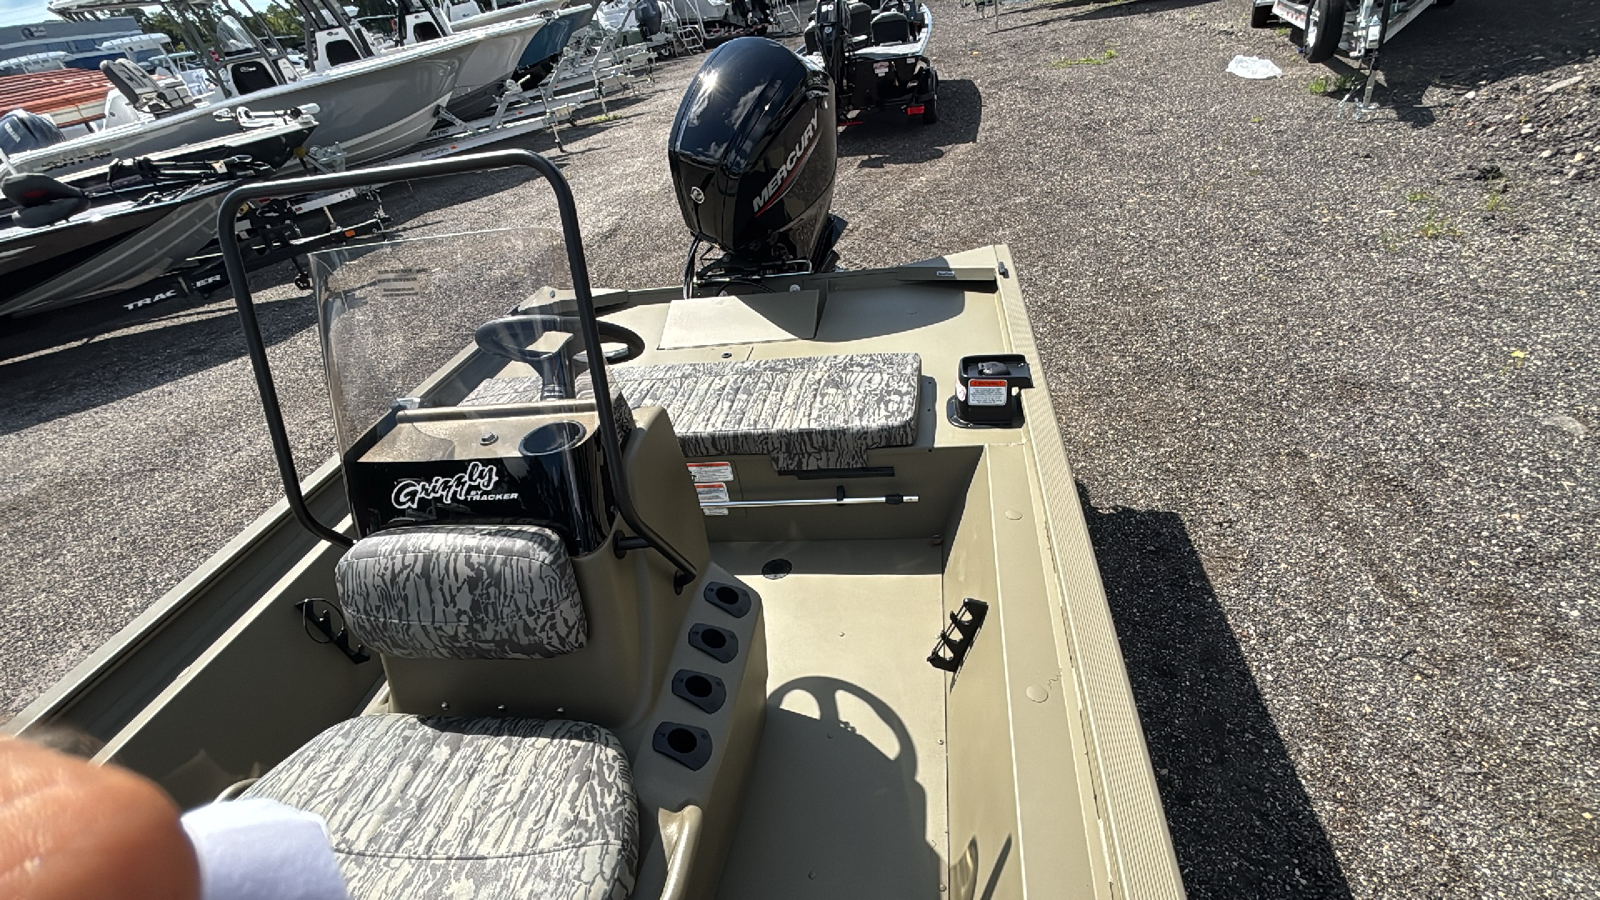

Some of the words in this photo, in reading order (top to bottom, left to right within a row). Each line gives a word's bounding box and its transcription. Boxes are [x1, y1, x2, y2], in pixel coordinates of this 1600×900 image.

[753, 108, 818, 213] MERCURY
[123, 274, 221, 311] TRACER
[391, 461, 499, 509] Grizzly
[466, 493, 519, 501] TRACKER
